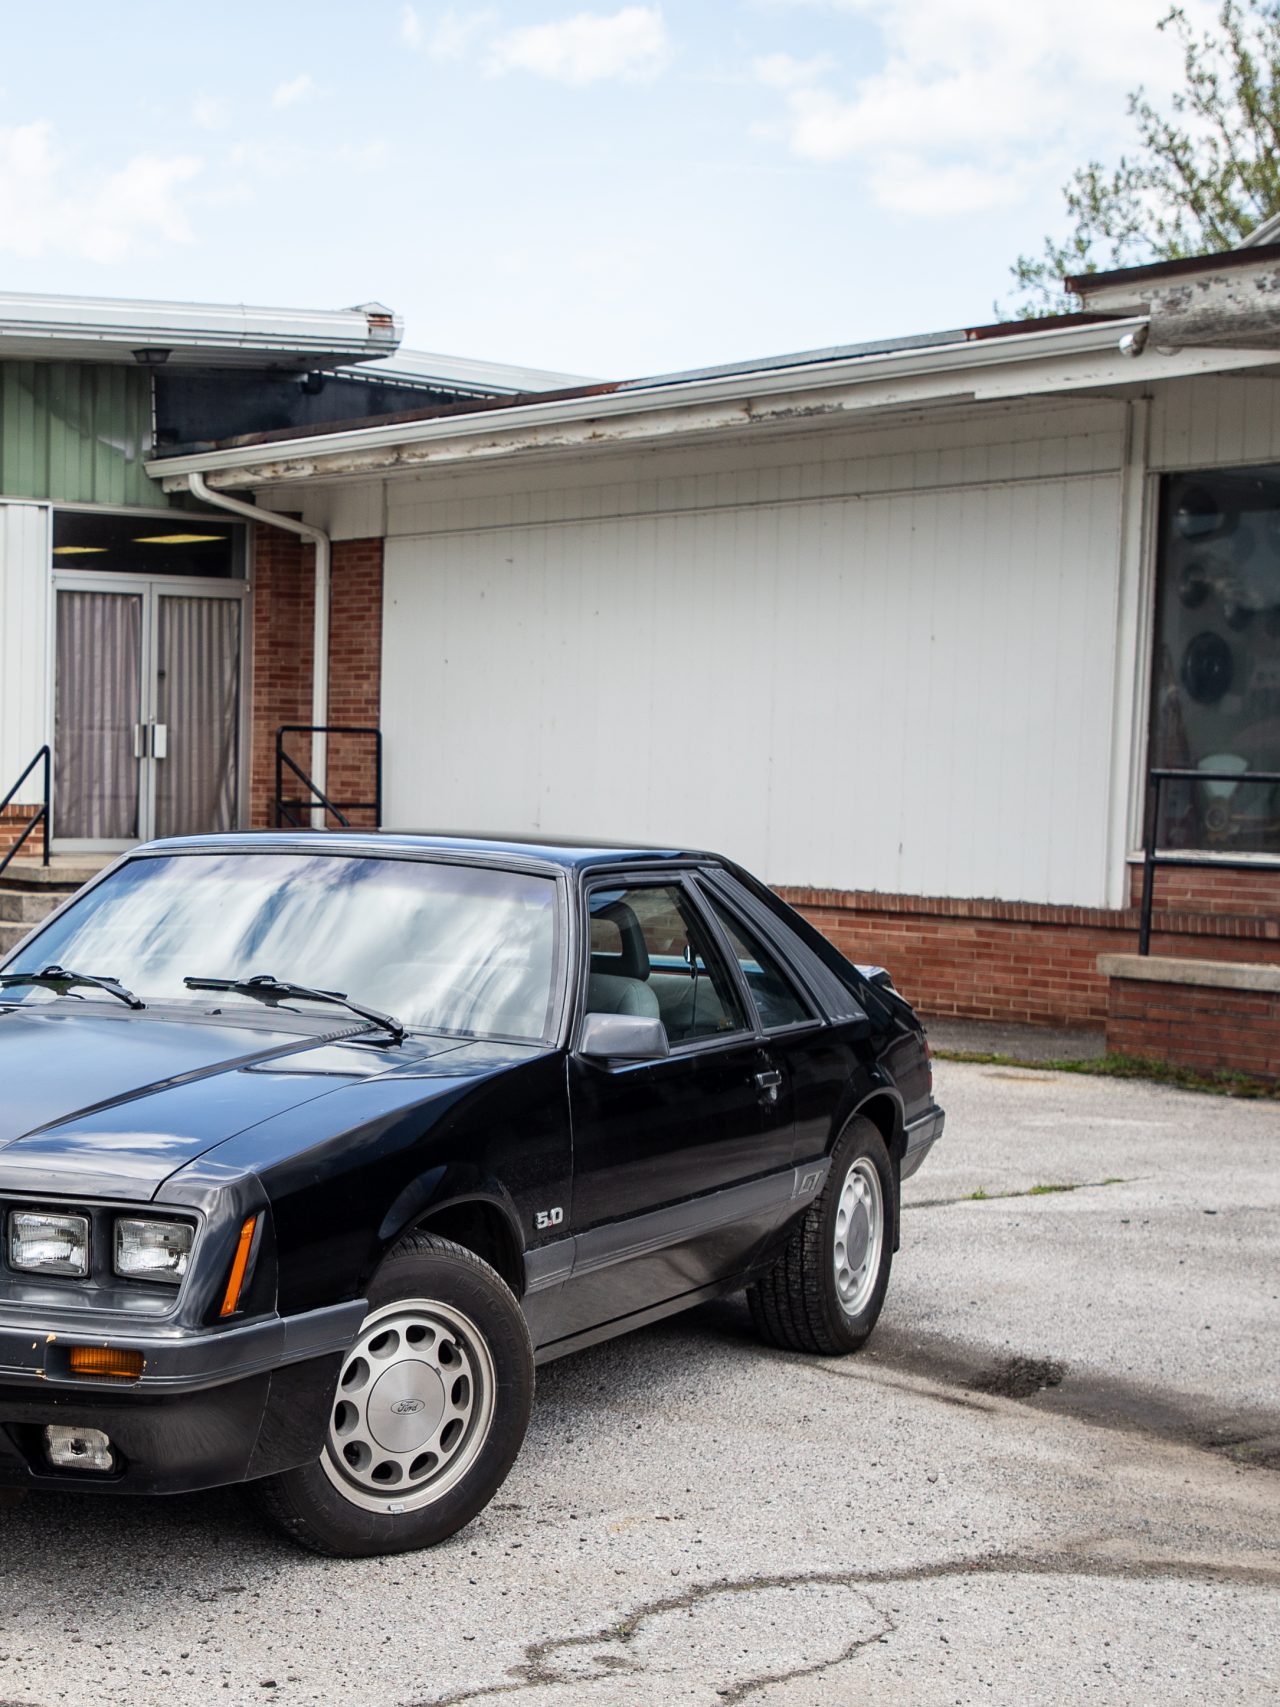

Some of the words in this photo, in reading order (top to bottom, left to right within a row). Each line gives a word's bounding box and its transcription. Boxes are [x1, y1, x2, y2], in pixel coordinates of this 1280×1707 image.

[798, 1170, 824, 1195] GT
[535, 1206, 564, 1230] 5.0
[397, 1401, 419, 1412] Ford
